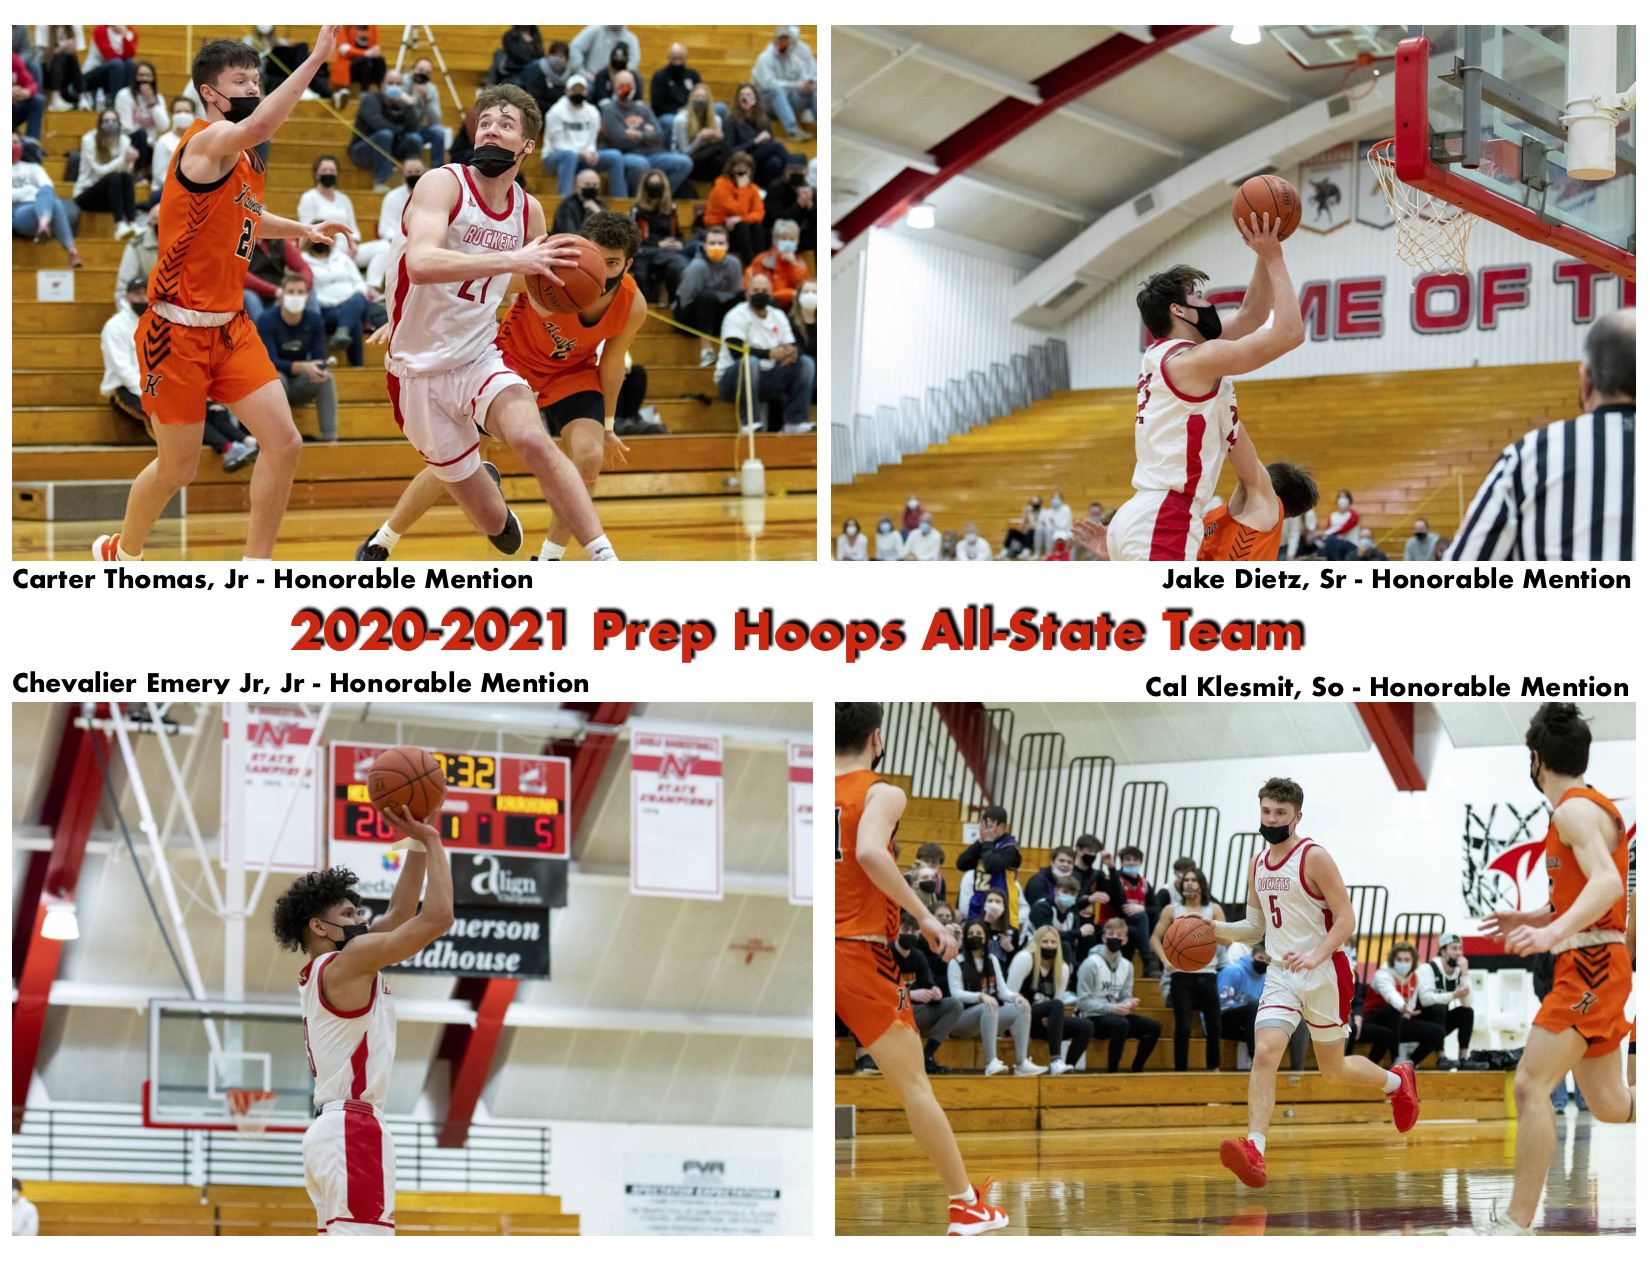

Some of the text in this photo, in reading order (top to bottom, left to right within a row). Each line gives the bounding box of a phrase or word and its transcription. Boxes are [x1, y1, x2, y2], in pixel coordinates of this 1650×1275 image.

[463, 225, 518, 250] ROCKETS
[1411, 263, 1531, 334] OF
[1553, 259, 1636, 324] T
[144, 374, 163, 397] K
[534, 816, 553, 851] 5
[1269, 895, 1282, 929] 5
[441, 917, 541, 941] nerson
[896, 987, 910, 1012] K
[1571, 991, 1599, 1014] K
